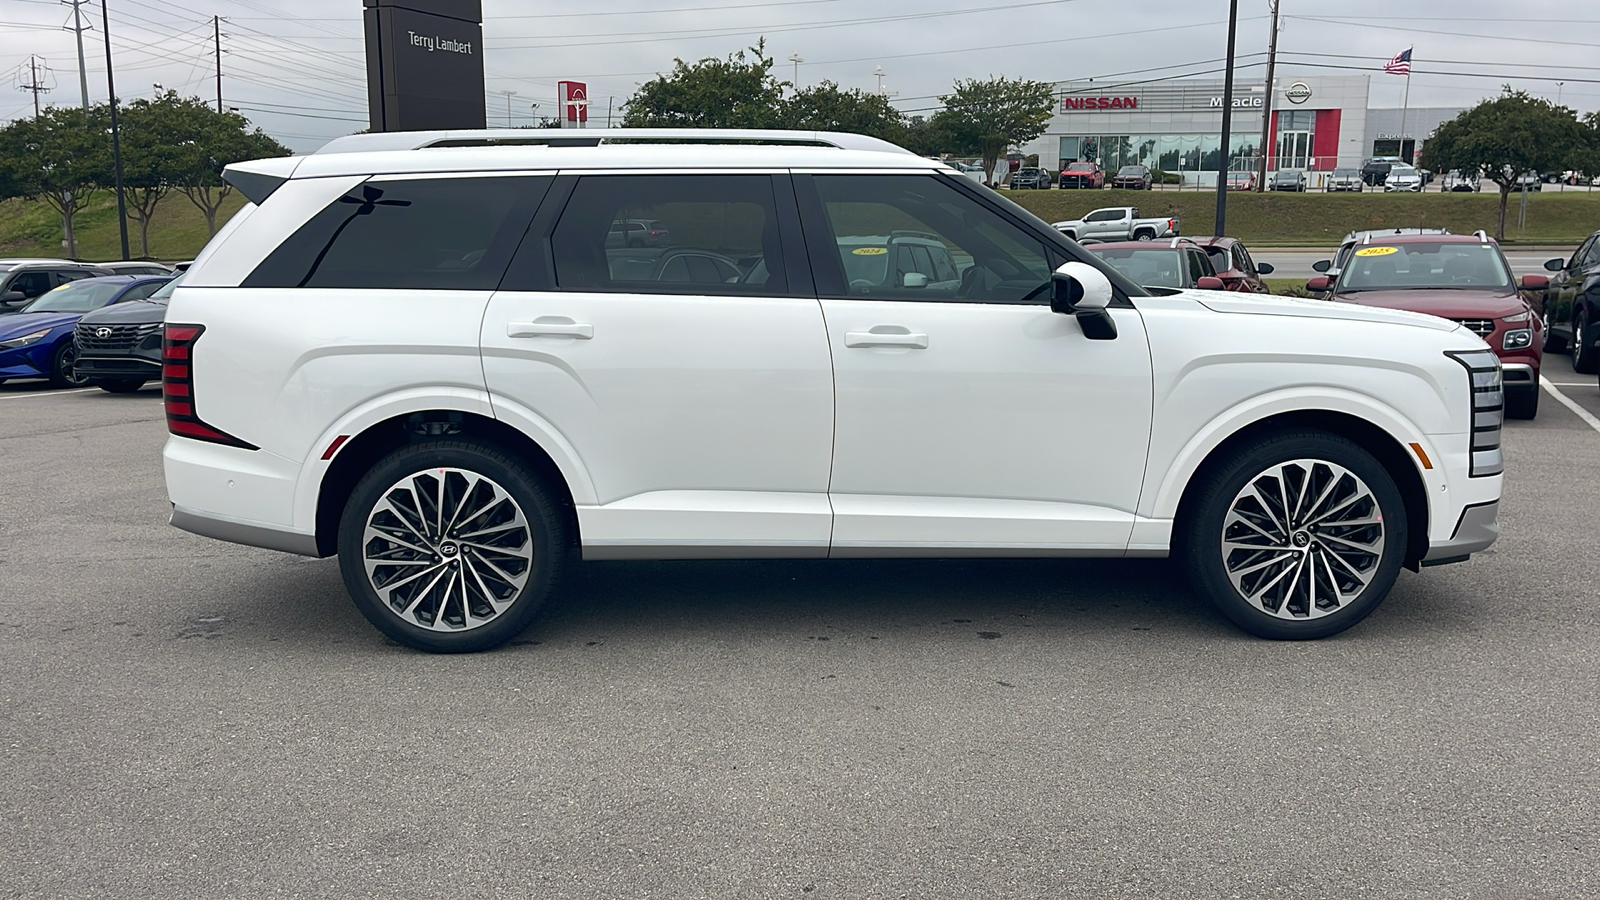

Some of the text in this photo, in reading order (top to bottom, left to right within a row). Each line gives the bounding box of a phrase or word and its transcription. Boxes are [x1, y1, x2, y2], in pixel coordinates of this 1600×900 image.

[407, 30, 472, 55] Terry Lambert
[1065, 96, 1137, 109] NISSAN
[1209, 96, 1262, 107] Macle
[1362, 247, 1391, 256] 2025
